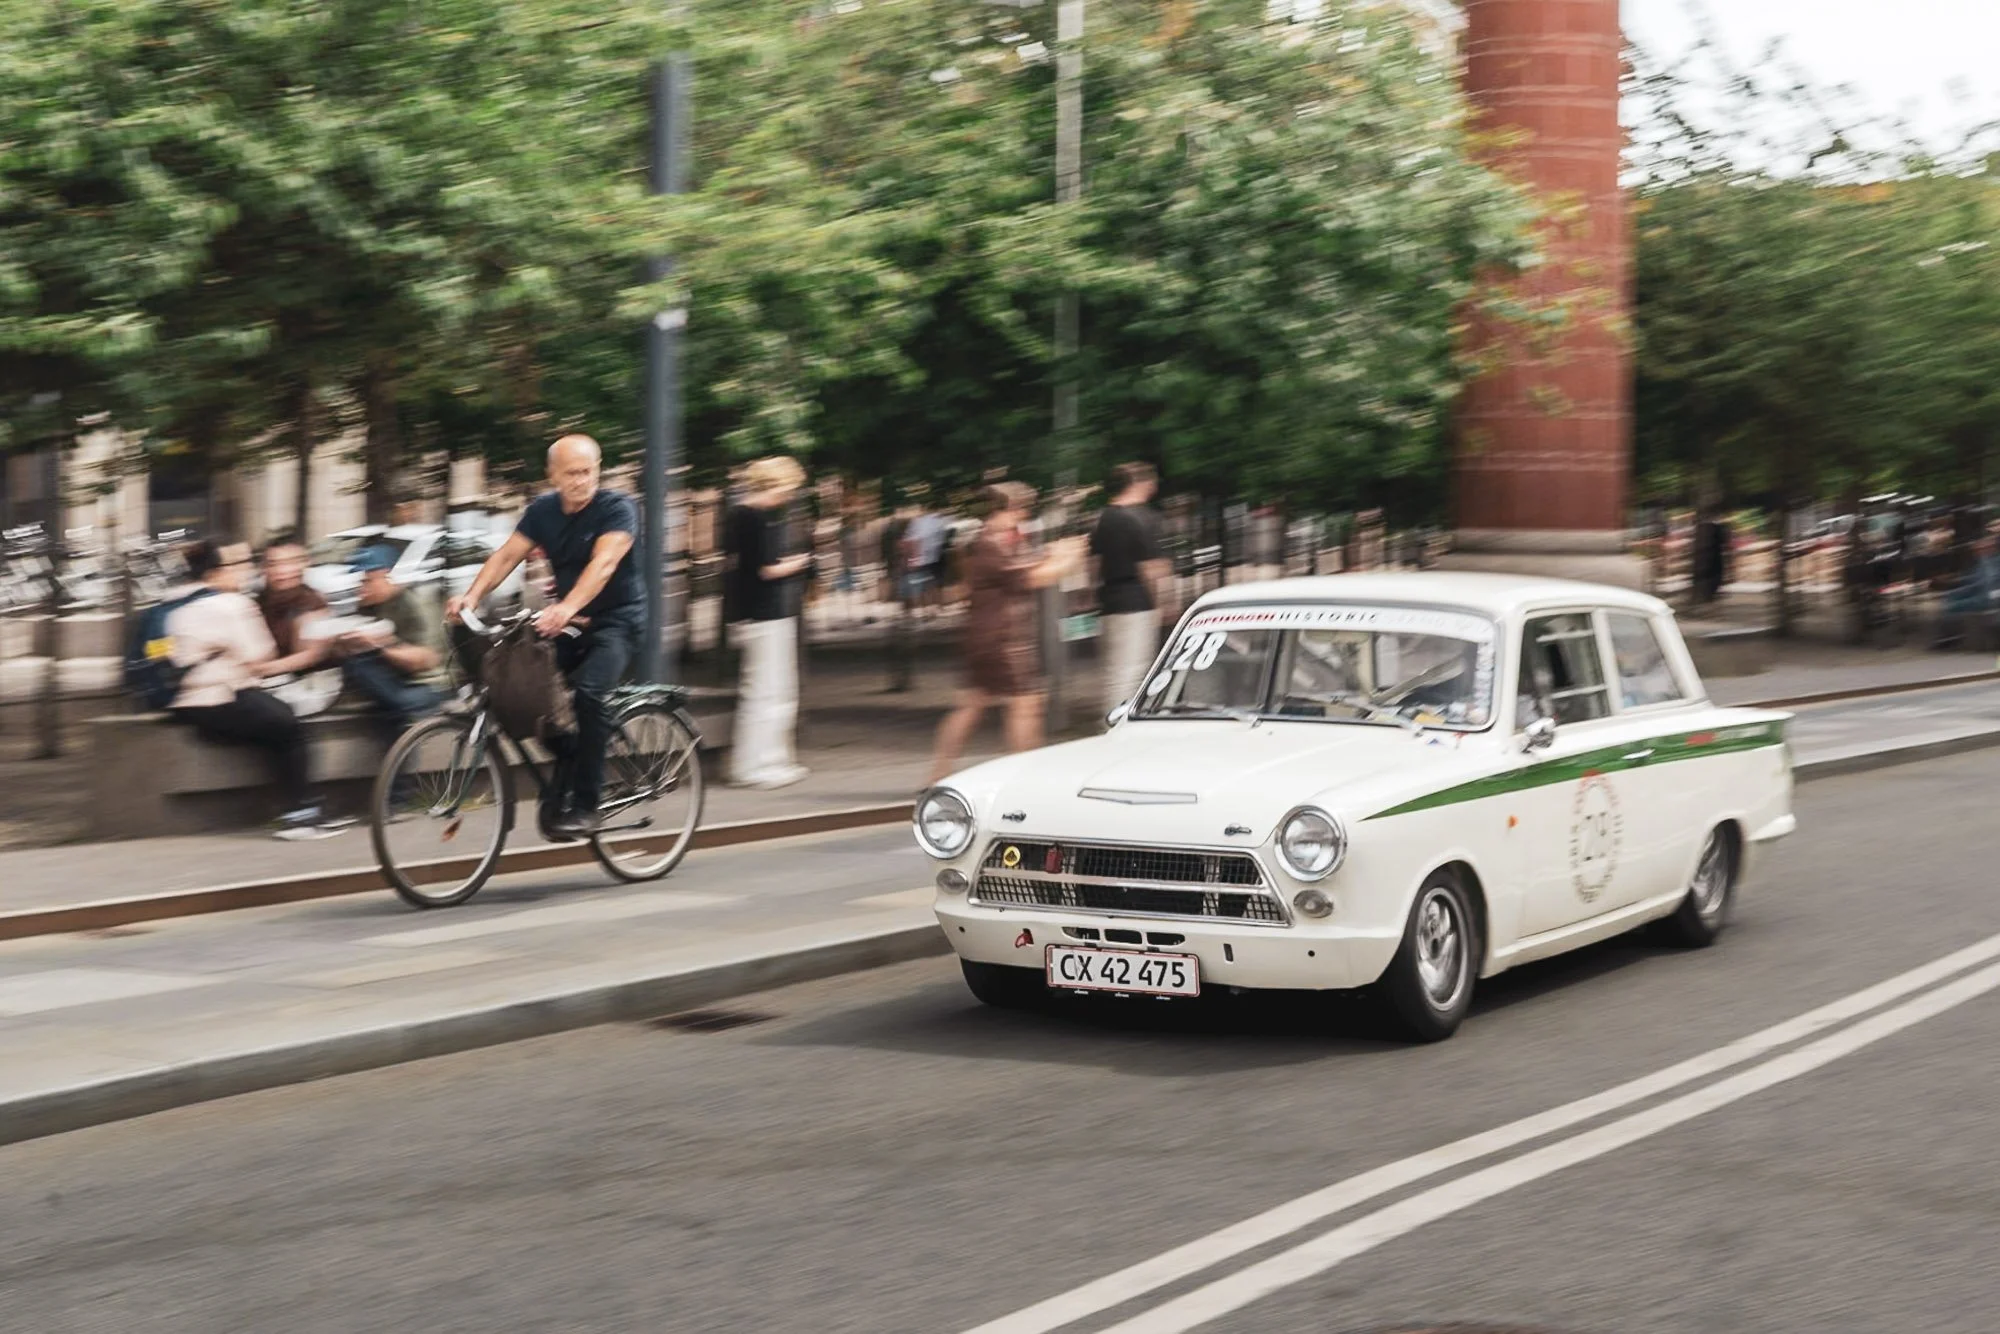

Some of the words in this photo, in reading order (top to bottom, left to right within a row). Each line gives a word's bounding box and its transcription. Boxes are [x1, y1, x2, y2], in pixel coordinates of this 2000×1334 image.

[1278, 610, 1377, 622] HISTORIC
[1171, 631, 1228, 671] 28
[1060, 953, 1093, 982] CX
[1100, 957, 1131, 985] 42
[1138, 960, 1186, 988] 475
